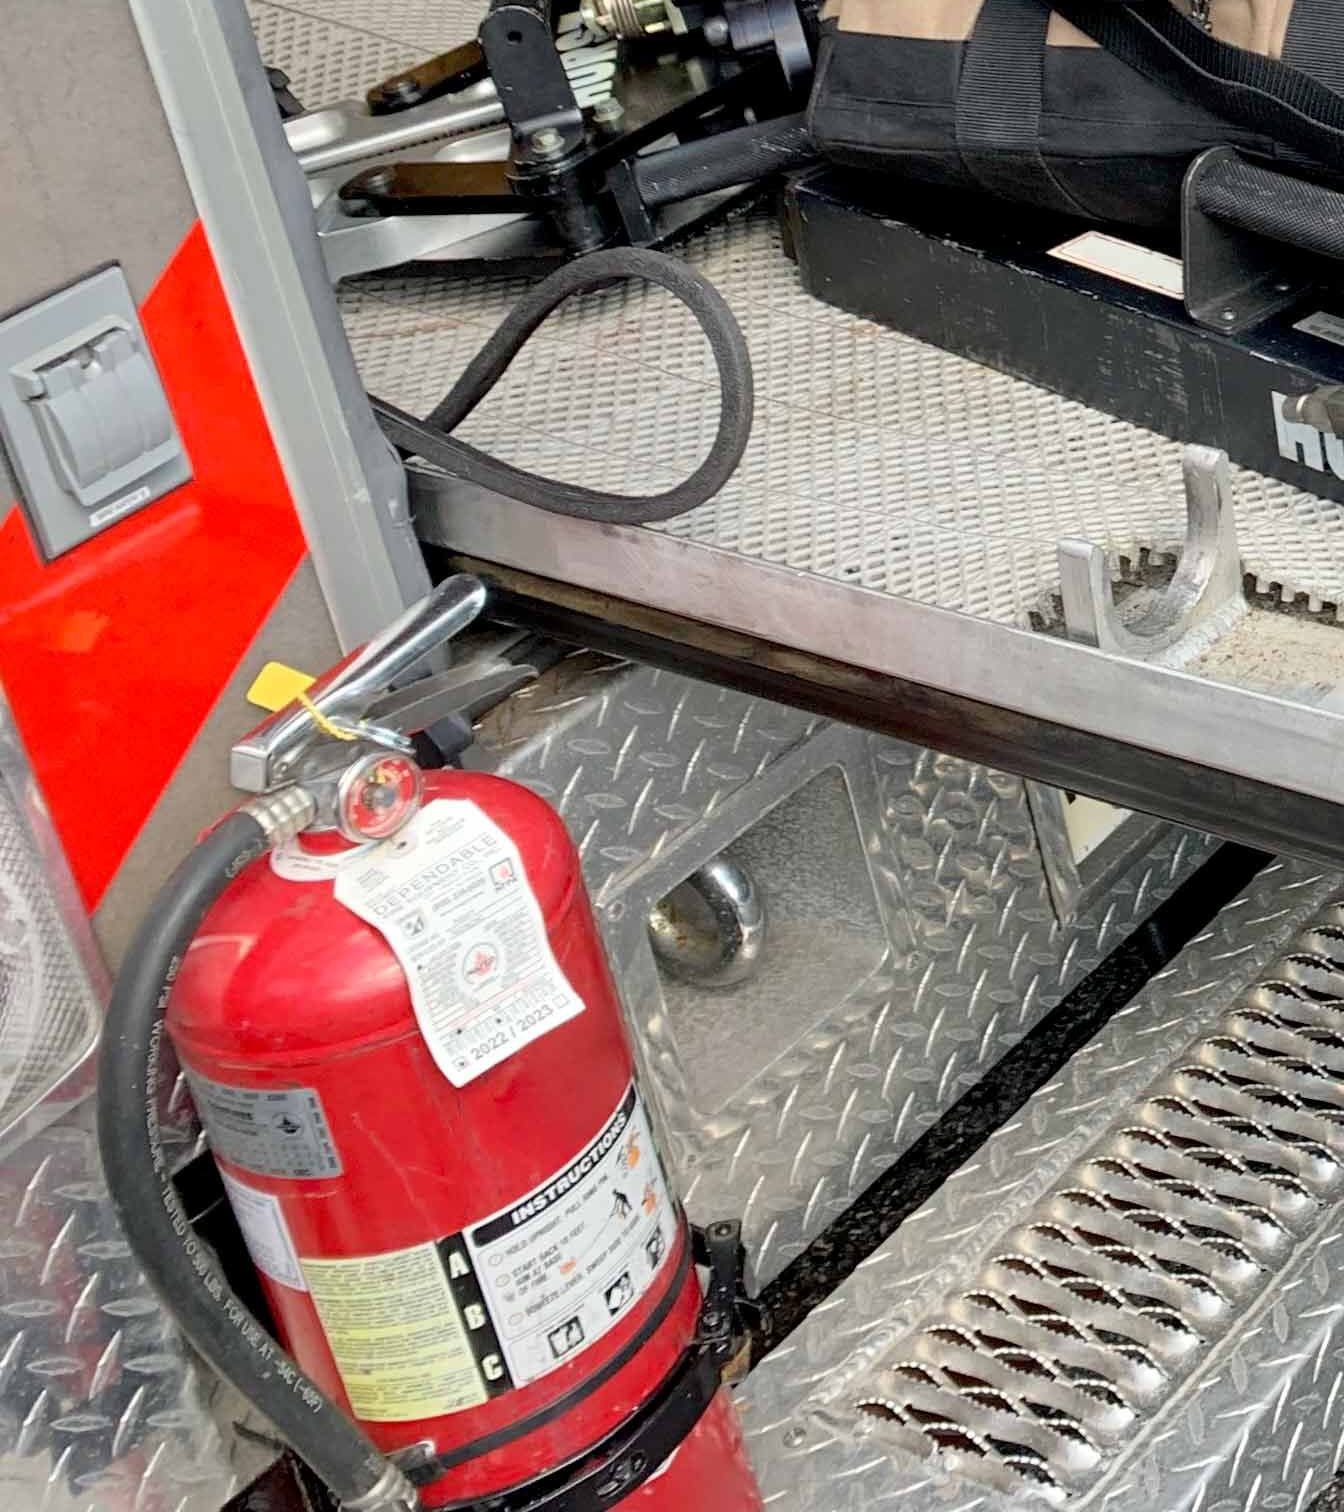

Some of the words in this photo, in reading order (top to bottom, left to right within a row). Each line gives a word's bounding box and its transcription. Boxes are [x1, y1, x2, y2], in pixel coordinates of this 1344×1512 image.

[372, 834, 498, 917] DEPENDABLE
[470, 1031, 510, 1061] 2022
[516, 1004, 555, 1032] 2023
[511, 1111, 627, 1226] INSTRUCTIONS
[448, 1250, 470, 1280] A
[223, 1298, 242, 1331] FOR
[258, 1341, 275, 1362] AT
[463, 1303, 486, 1331] B
[481, 1354, 504, 1381] C
